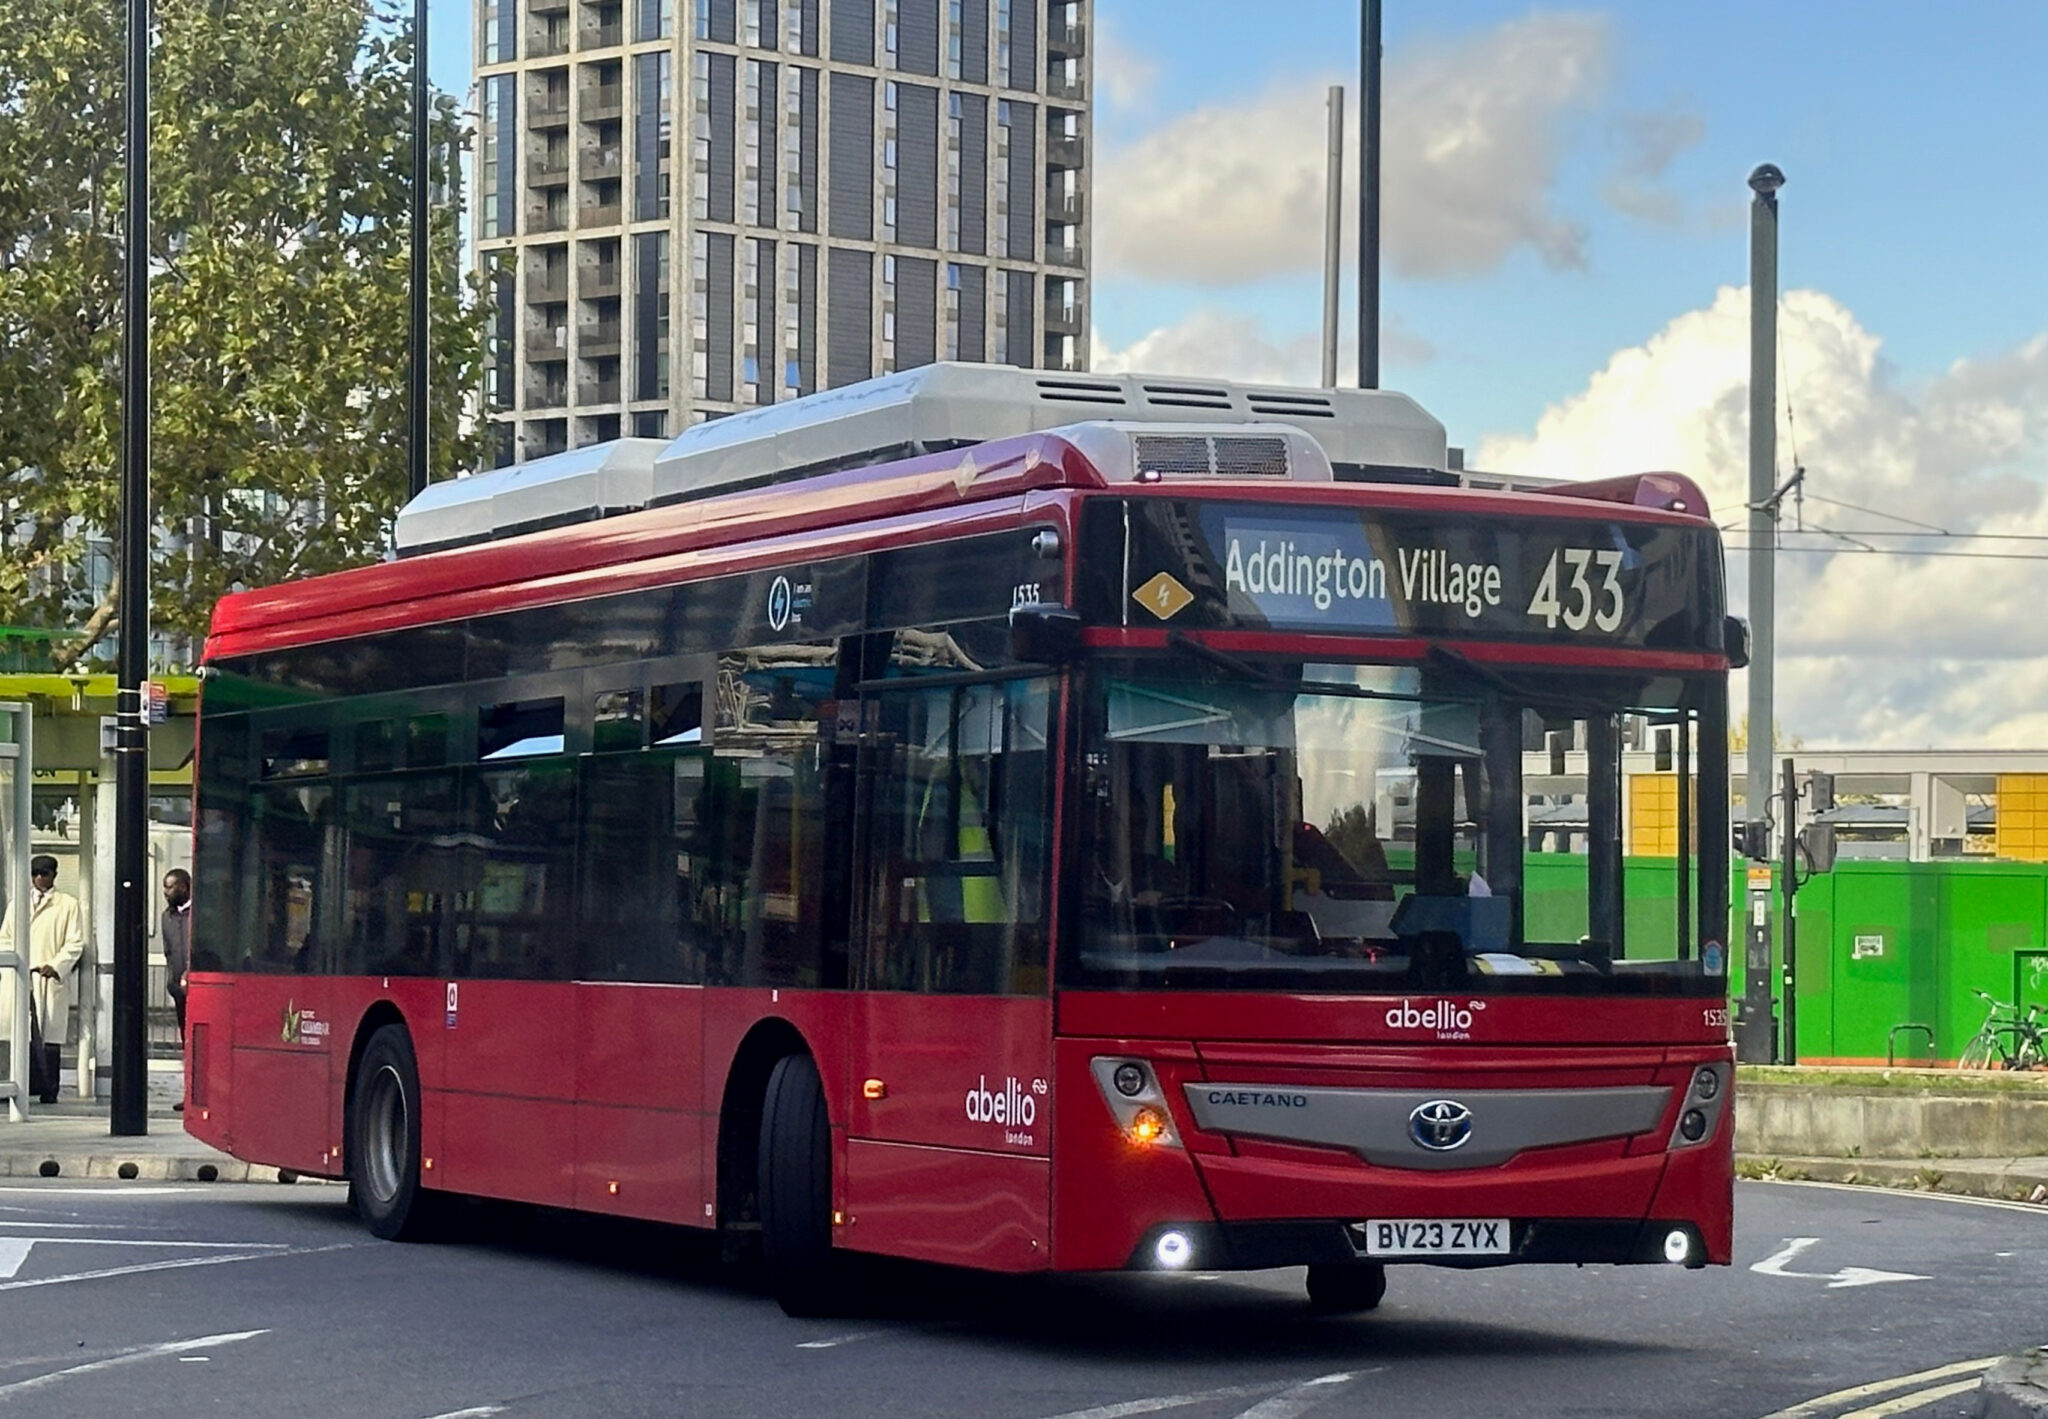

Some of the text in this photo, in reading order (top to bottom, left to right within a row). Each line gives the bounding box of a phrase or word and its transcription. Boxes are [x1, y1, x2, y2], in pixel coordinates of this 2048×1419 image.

[1225, 538, 1501, 618] Addington Village
[1527, 547, 1625, 633] 433
[1012, 583, 1040, 607] 1535
[1385, 999, 1472, 1029] abellio
[965, 1074, 1035, 1126] abellio
[1208, 1091, 1307, 1107] CAETANO
[1005, 1130, 1034, 1146] london
[1377, 1223, 1499, 1249] BV23 ZYX
